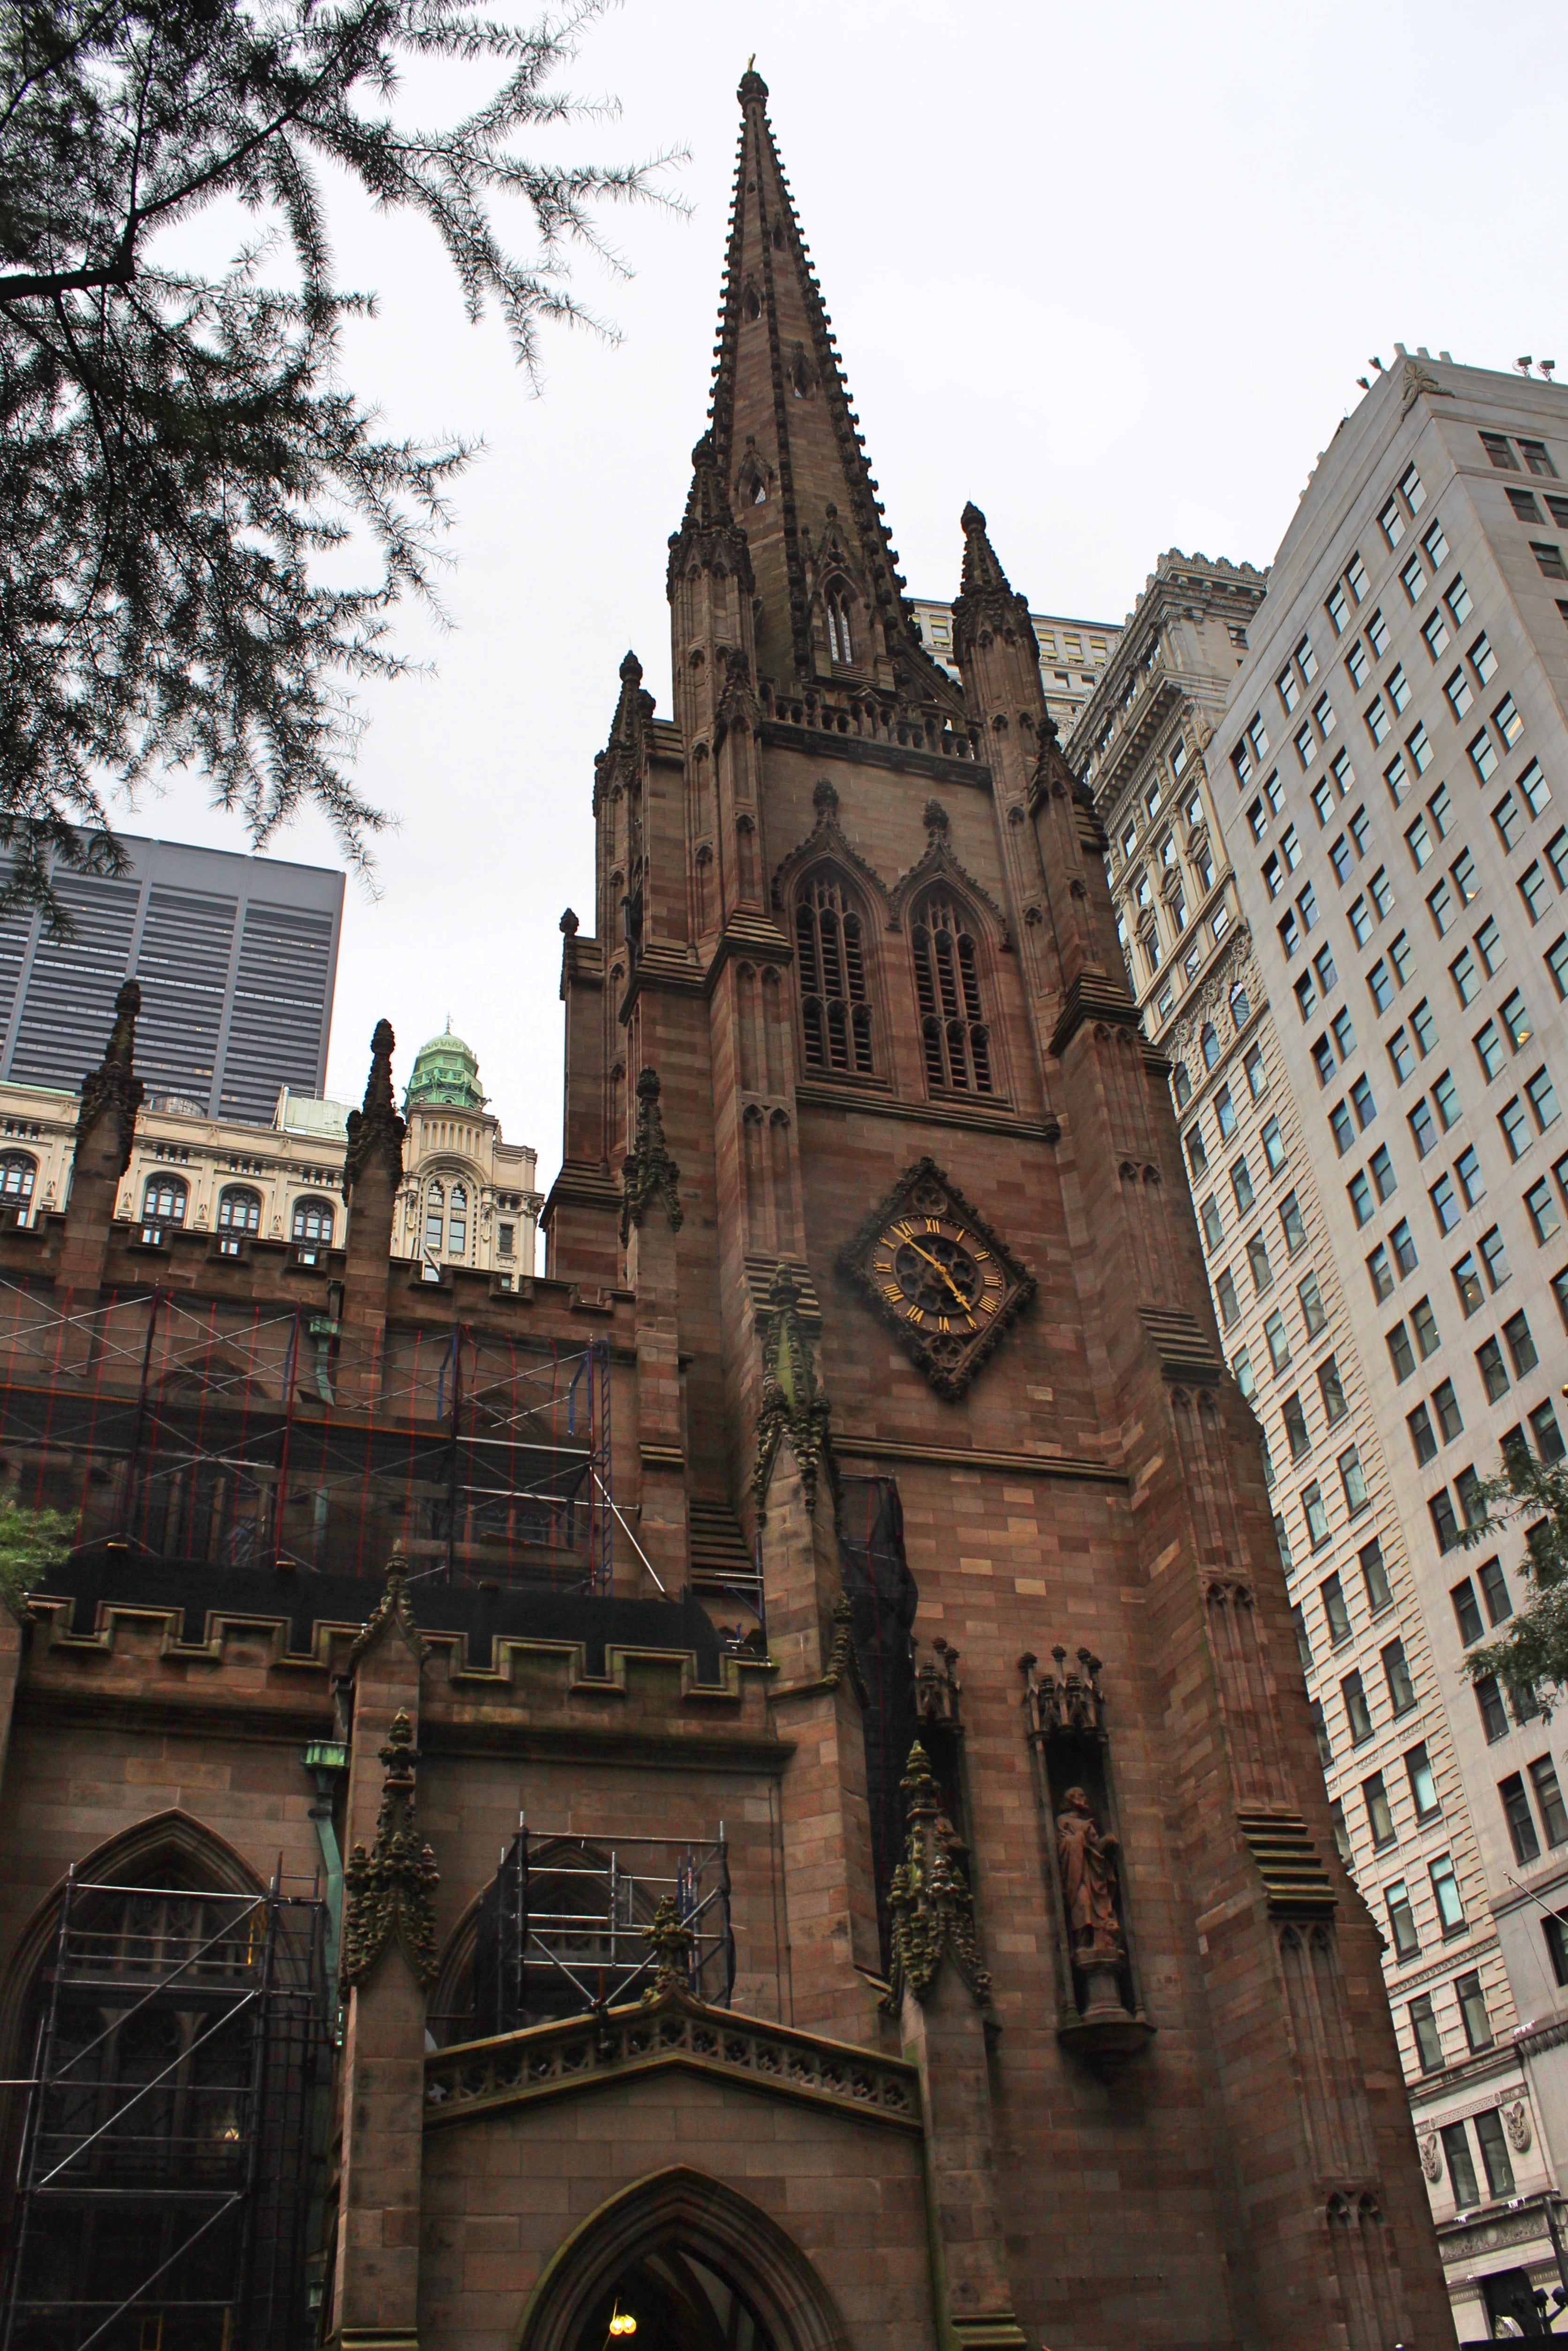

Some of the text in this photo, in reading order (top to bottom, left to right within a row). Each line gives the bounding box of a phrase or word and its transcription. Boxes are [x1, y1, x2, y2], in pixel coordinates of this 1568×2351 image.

[898, 1221, 914, 1236] XI
[925, 1219, 940, 1234] XII
[880, 1237, 897, 1250] X
[974, 1251, 989, 1261] II
[875, 1261, 892, 1272] IX
[984, 1275, 1000, 1286] III
[883, 1283, 905, 1303] VIII
[978, 1295, 997, 1313] IIII
[906, 1304, 924, 1323] VII
[965, 1313, 977, 1327] V
[939, 1316, 951, 1331] VI
